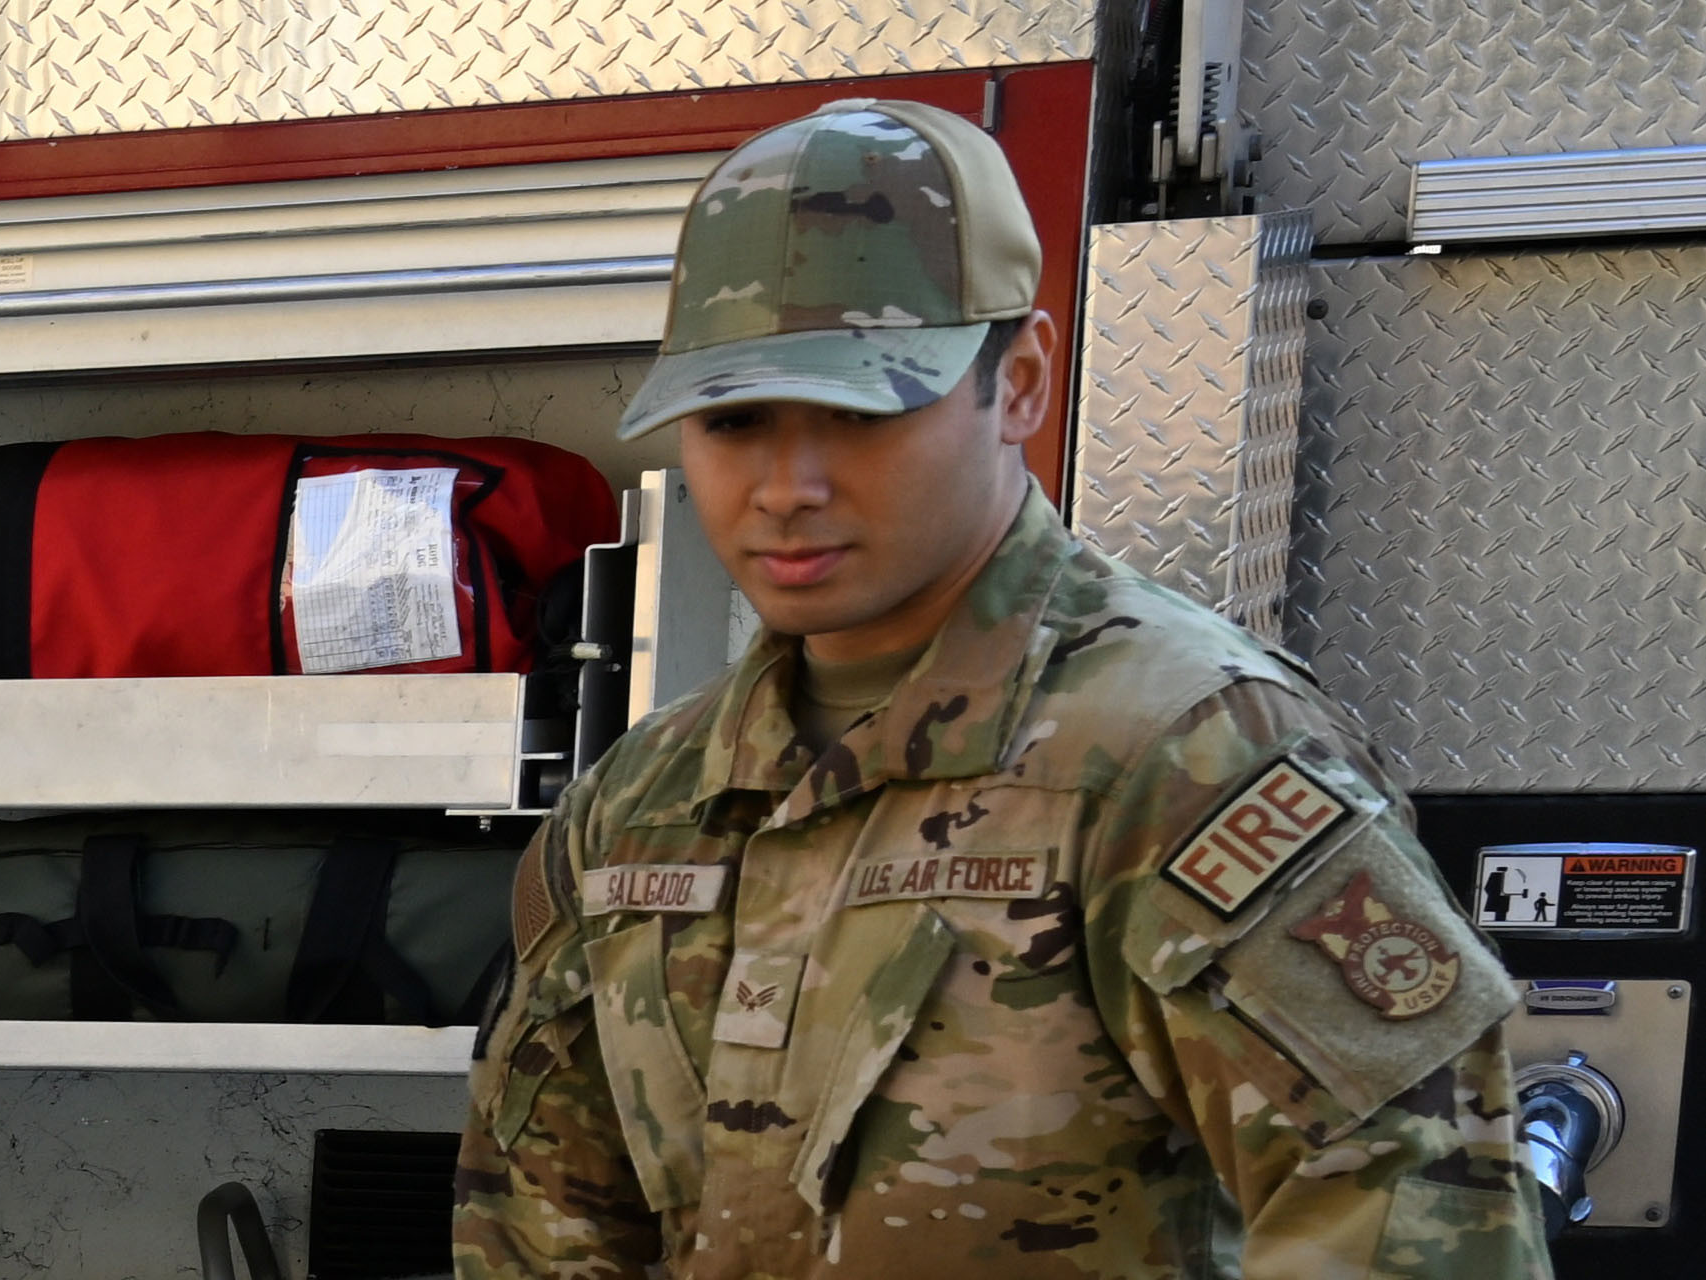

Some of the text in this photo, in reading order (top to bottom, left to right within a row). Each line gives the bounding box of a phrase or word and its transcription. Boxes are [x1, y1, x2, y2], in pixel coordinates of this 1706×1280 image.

[1178, 772, 1334, 905] FIRE
[859, 856, 1036, 895] U.S. AIR FORCE
[1589, 859, 1676, 871] WARNING
[607, 872, 696, 906] SALGADO
[1348, 923, 1439, 962] PROTECTION
[1352, 970, 1380, 998] FIRE
[1404, 970, 1449, 1009] USAF
